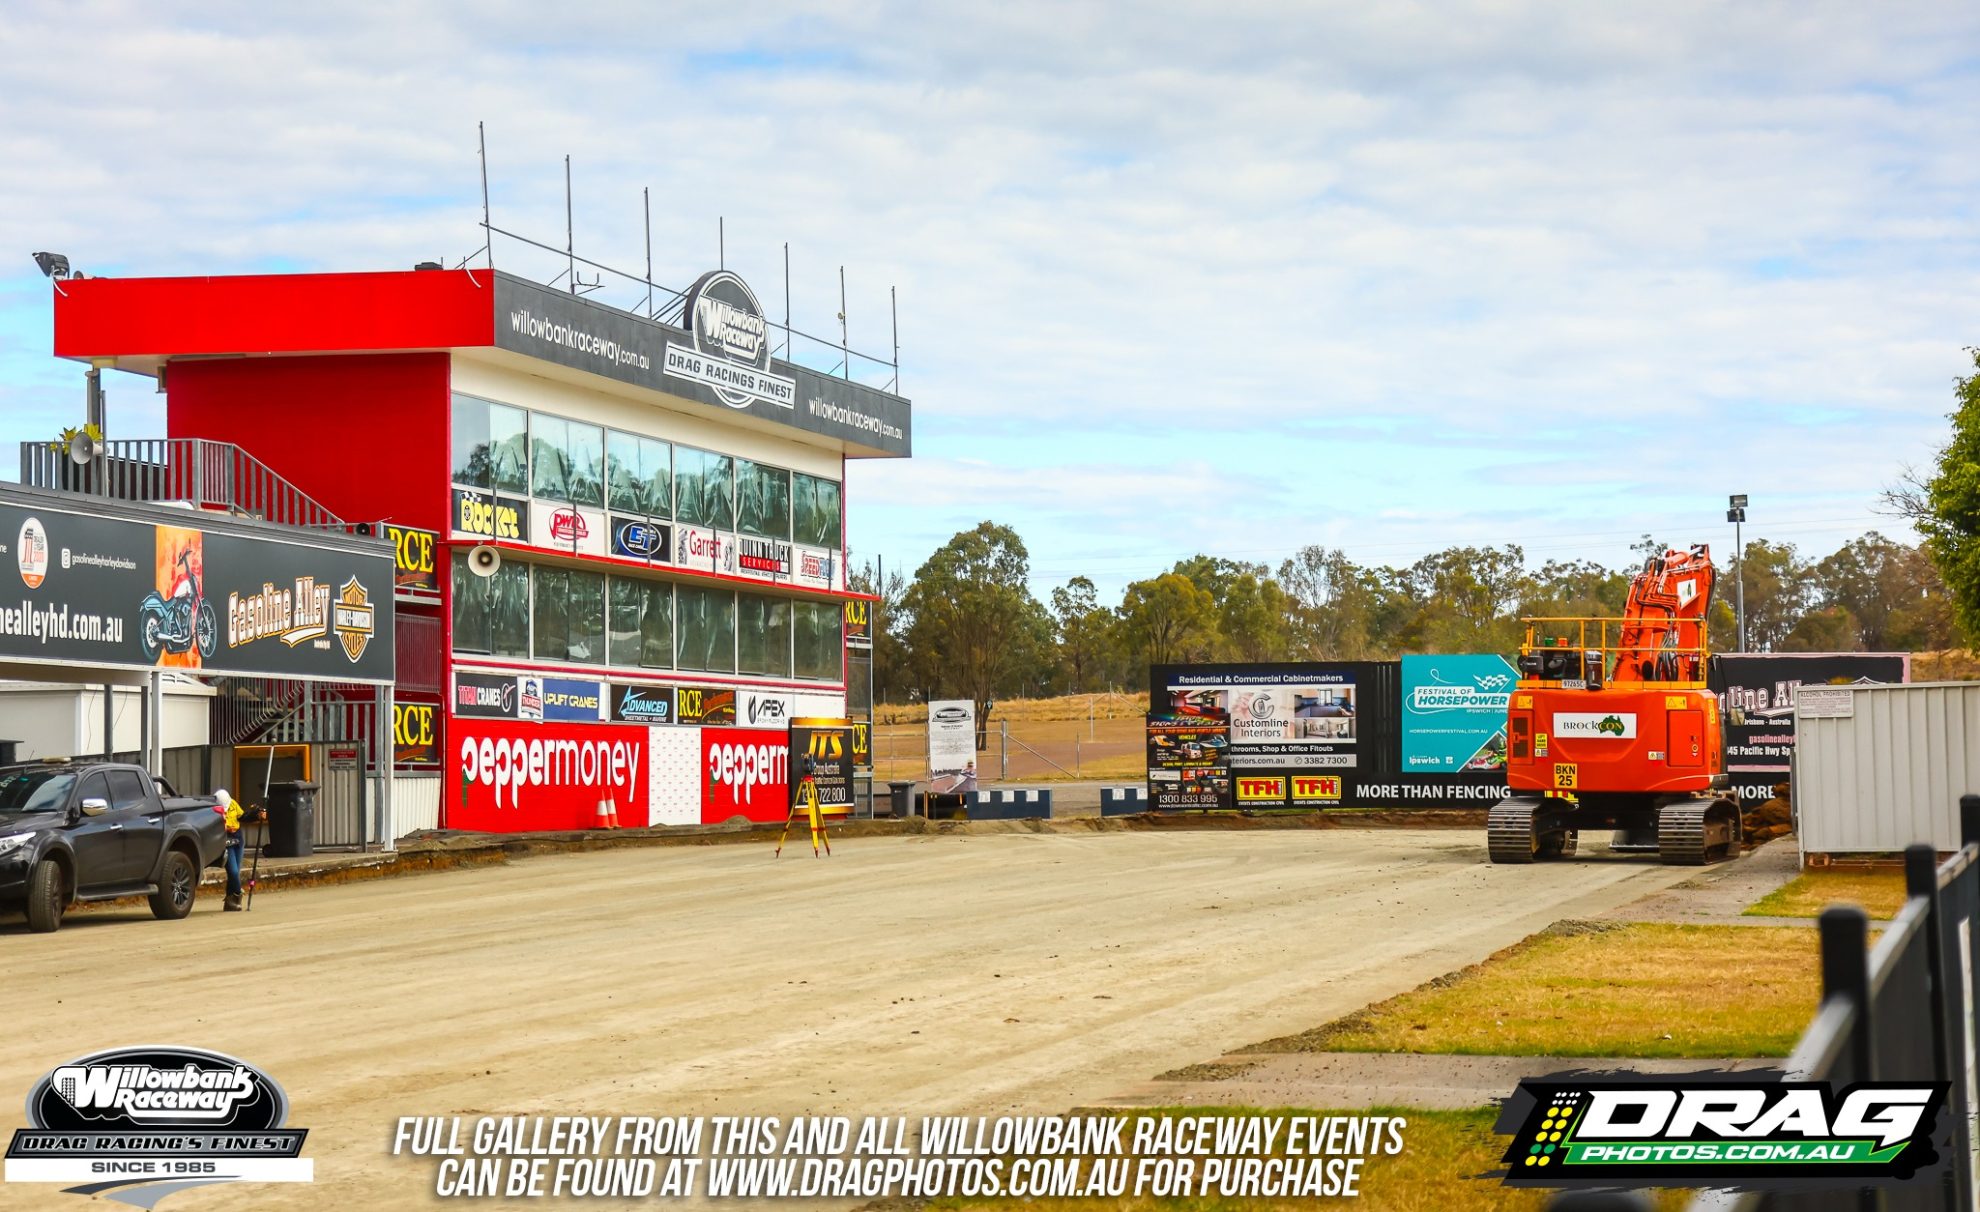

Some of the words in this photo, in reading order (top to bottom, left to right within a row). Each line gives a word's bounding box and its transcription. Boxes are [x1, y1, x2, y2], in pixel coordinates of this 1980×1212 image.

[700, 298, 765, 343] Willowbank
[511, 309, 650, 371] willowbankraceway.com.au
[719, 322, 761, 360] Raceway
[668, 351, 701, 374] DRAG
[706, 363, 755, 389] RACINGS
[758, 378, 793, 400] FINEST
[808, 397, 903, 440] willowbankraceway.com.au
[388, 527, 434, 573] RCE
[742, 556, 780, 571] SERVICS
[228, 582, 291, 648] Gasoline
[293, 576, 331, 633] Alley
[1179, 675, 1223, 684] Residential
[1224, 675, 1232, 683] &
[1233, 675, 1281, 684] Commercial
[1283, 674, 1343, 683] Cabinetmakers
[477, 687, 501, 707] CRANES
[544, 693, 568, 706] UPLIFT
[619, 686, 668, 716] ADVANCED
[678, 690, 703, 717] RCE
[1418, 695, 1507, 706] HORSEPOWER
[757, 699, 785, 718] APEX
[393, 704, 433, 746] RCE
[1233, 718, 1289, 728] Customline
[852, 723, 868, 755] CE
[1240, 728, 1281, 738] Interiors
[1749, 734, 1796, 744] gasolinealley
[808, 730, 845, 760] JTS
[1231, 745, 1261, 753] throoms,
[1262, 745, 1280, 753] Shop
[1288, 744, 1308, 752] Office
[1309, 744, 1334, 752] Fitouts
[1727, 746, 1738, 756] 45
[1740, 746, 1763, 756] Pacific
[1765, 746, 1779, 757] Hwy
[1231, 756, 1285, 765] teriors.com.au
[1304, 757, 1325, 765] 3382
[1327, 756, 1348, 764] 7300
[1409, 756, 1440, 765] Ipswich
[461, 736, 640, 809] peppermoney
[709, 742, 789, 805] pepperm
[1555, 765, 1576, 775] BKN
[1240, 780, 1279, 796] TFH
[1295, 779, 1335, 795] TFH
[1558, 775, 1573, 787] 25
[818, 788, 831, 803] 722
[832, 787, 846, 802] 800
[1159, 795, 1180, 803] 1300
[1181, 795, 1198, 803] 833
[1200, 794, 1217, 803] 995
[1356, 784, 1399, 799] MORE
[1401, 784, 1442, 799] THAN
[1446, 785, 1511, 799] FENCING
